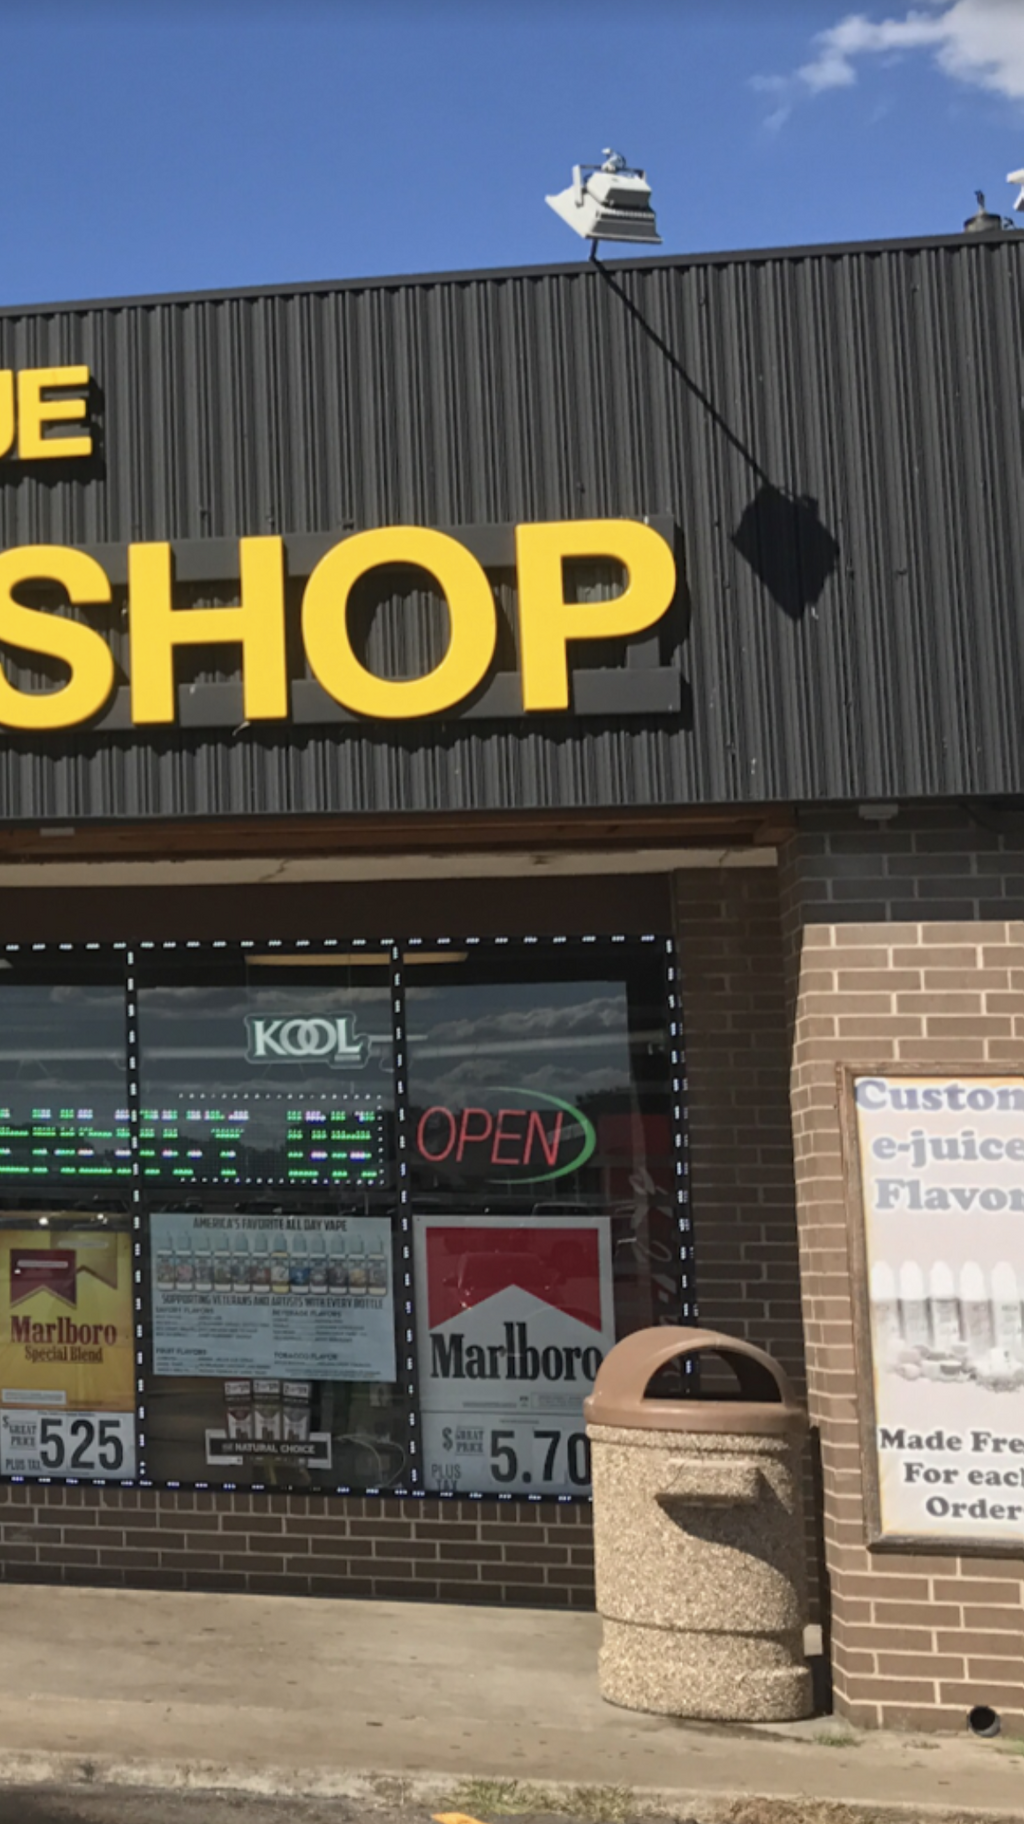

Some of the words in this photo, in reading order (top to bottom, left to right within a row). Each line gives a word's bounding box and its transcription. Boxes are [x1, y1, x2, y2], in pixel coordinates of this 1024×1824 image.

[254, 1018, 362, 1057] KOOL
[417, 1106, 564, 1166] OPEN
[193, 1217, 240, 1230] AMERICA'S
[242, 1217, 284, 1230] FAVORITE
[286, 1218, 302, 1230] ALL
[304, 1218, 322, 1231] DAY
[324, 1219, 348, 1232] VAPE
[162, 1294, 212, 1306] SUPPORTING
[327, 1297, 352, 1309] EVERY
[10, 1315, 117, 1345] Marlboro
[25, 1345, 68, 1363] Special
[70, 1346, 103, 1362] Blend
[430, 1321, 602, 1380] Marlboro
[40, 1418, 123, 1470] 525
[235, 1442, 278, 1453] NATURAL
[280, 1444, 316, 1454] CHOICE
[442, 1427, 453, 1451] $
[456, 1441, 484, 1453] PRICE
[880, 1428, 962, 1451] Made
[971, 1431, 1024, 1453] Fre
[5, 1458, 25, 1471] PLUS
[432, 1464, 461, 1480] PLUS
[903, 1463, 958, 1483] For
